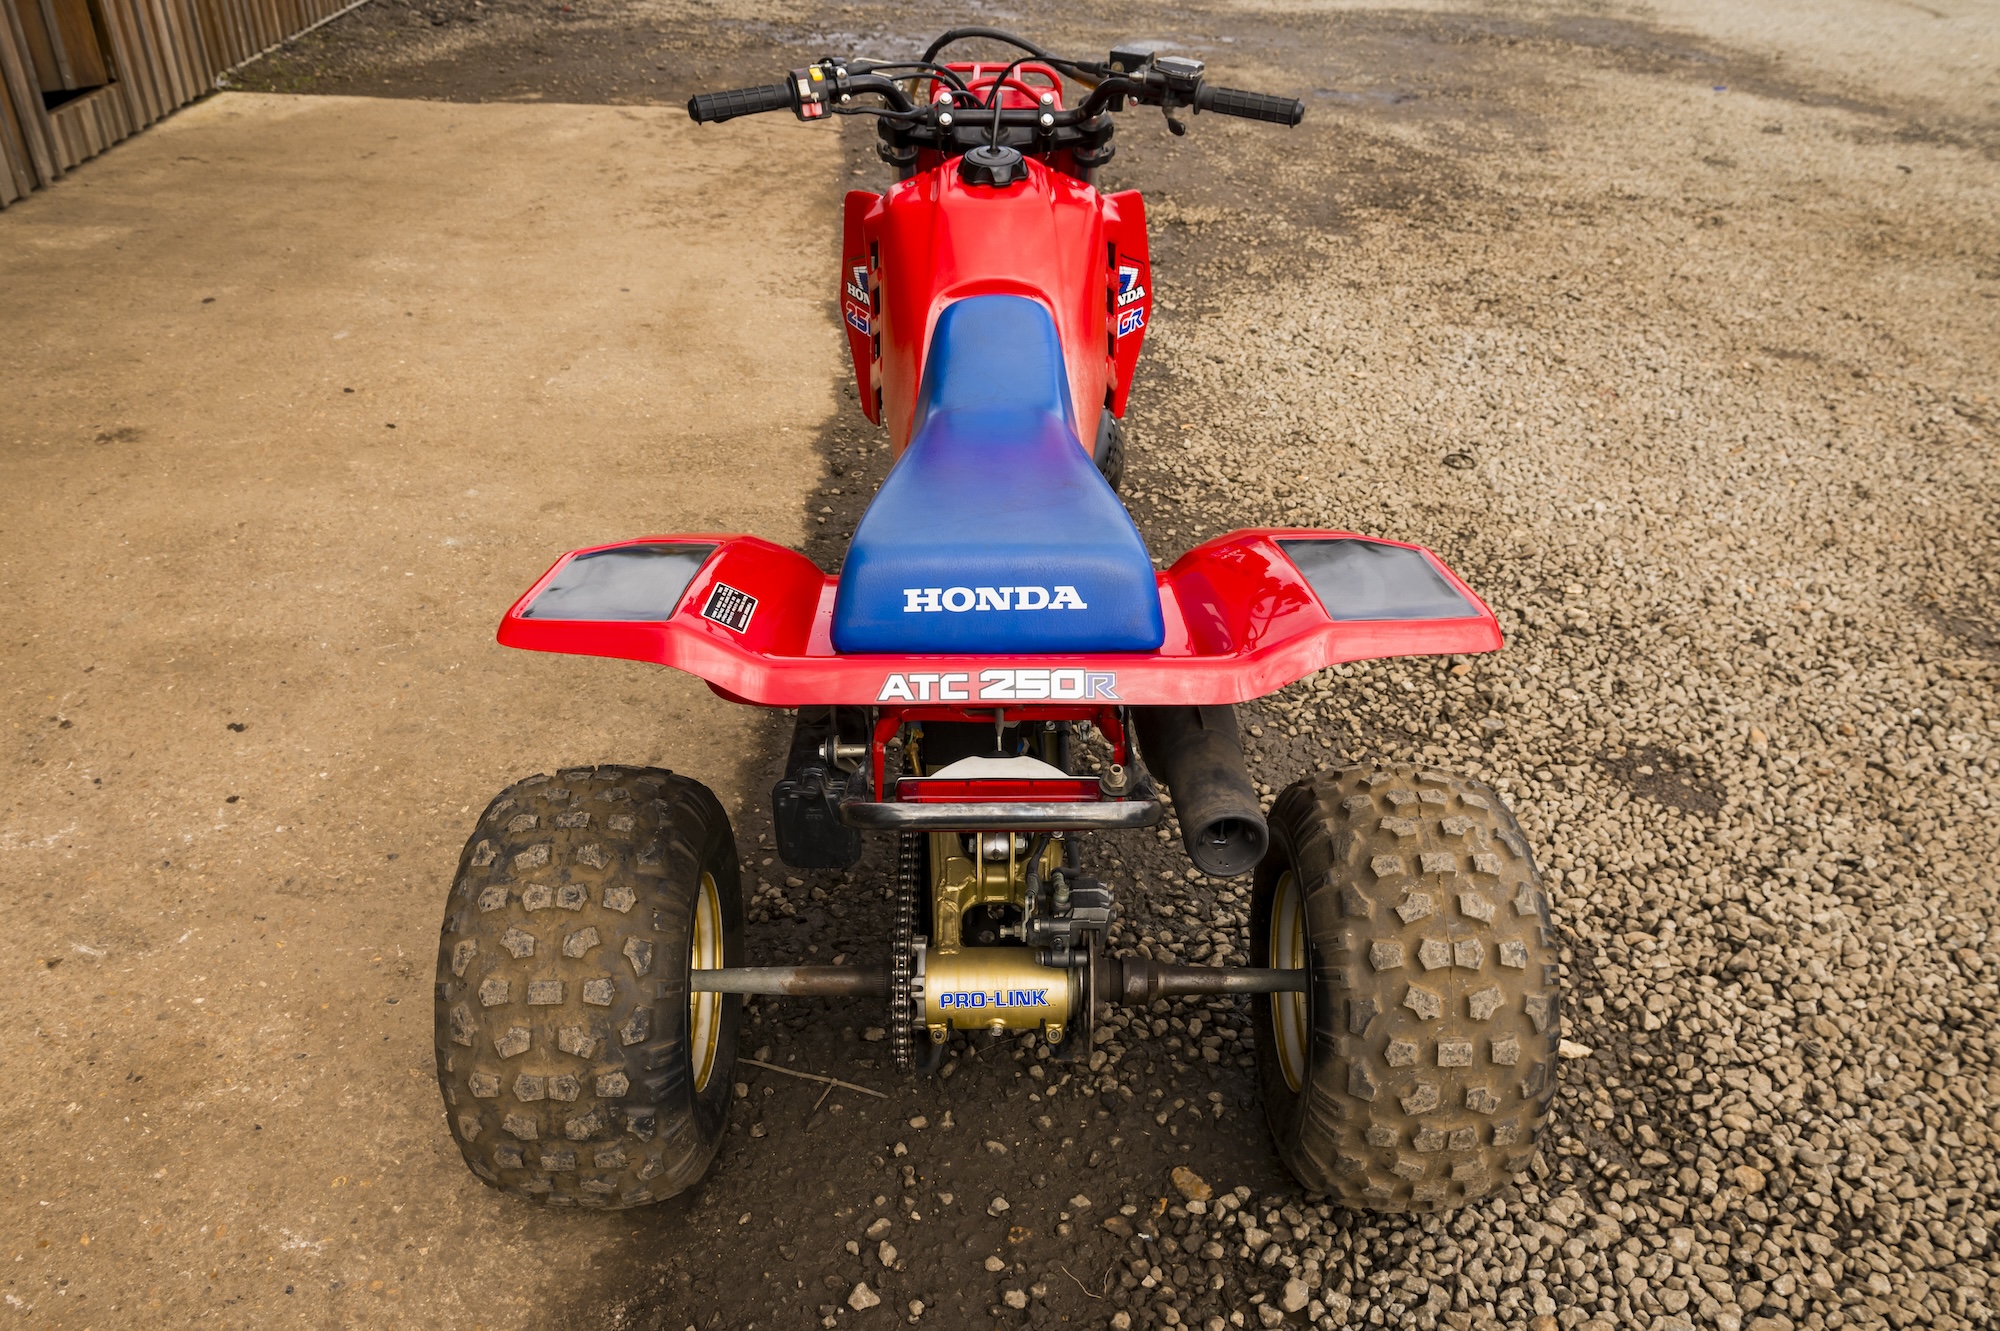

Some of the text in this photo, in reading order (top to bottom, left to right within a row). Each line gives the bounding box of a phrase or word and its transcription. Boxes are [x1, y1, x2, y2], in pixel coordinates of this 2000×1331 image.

[847, 282, 870, 306] HON
[1118, 286, 1146, 307] NDA
[846, 301, 871, 337] 25
[903, 586, 1087, 612] HONDA
[876, 673, 969, 701] ATC
[939, 989, 1050, 1009] PRO-LINK
